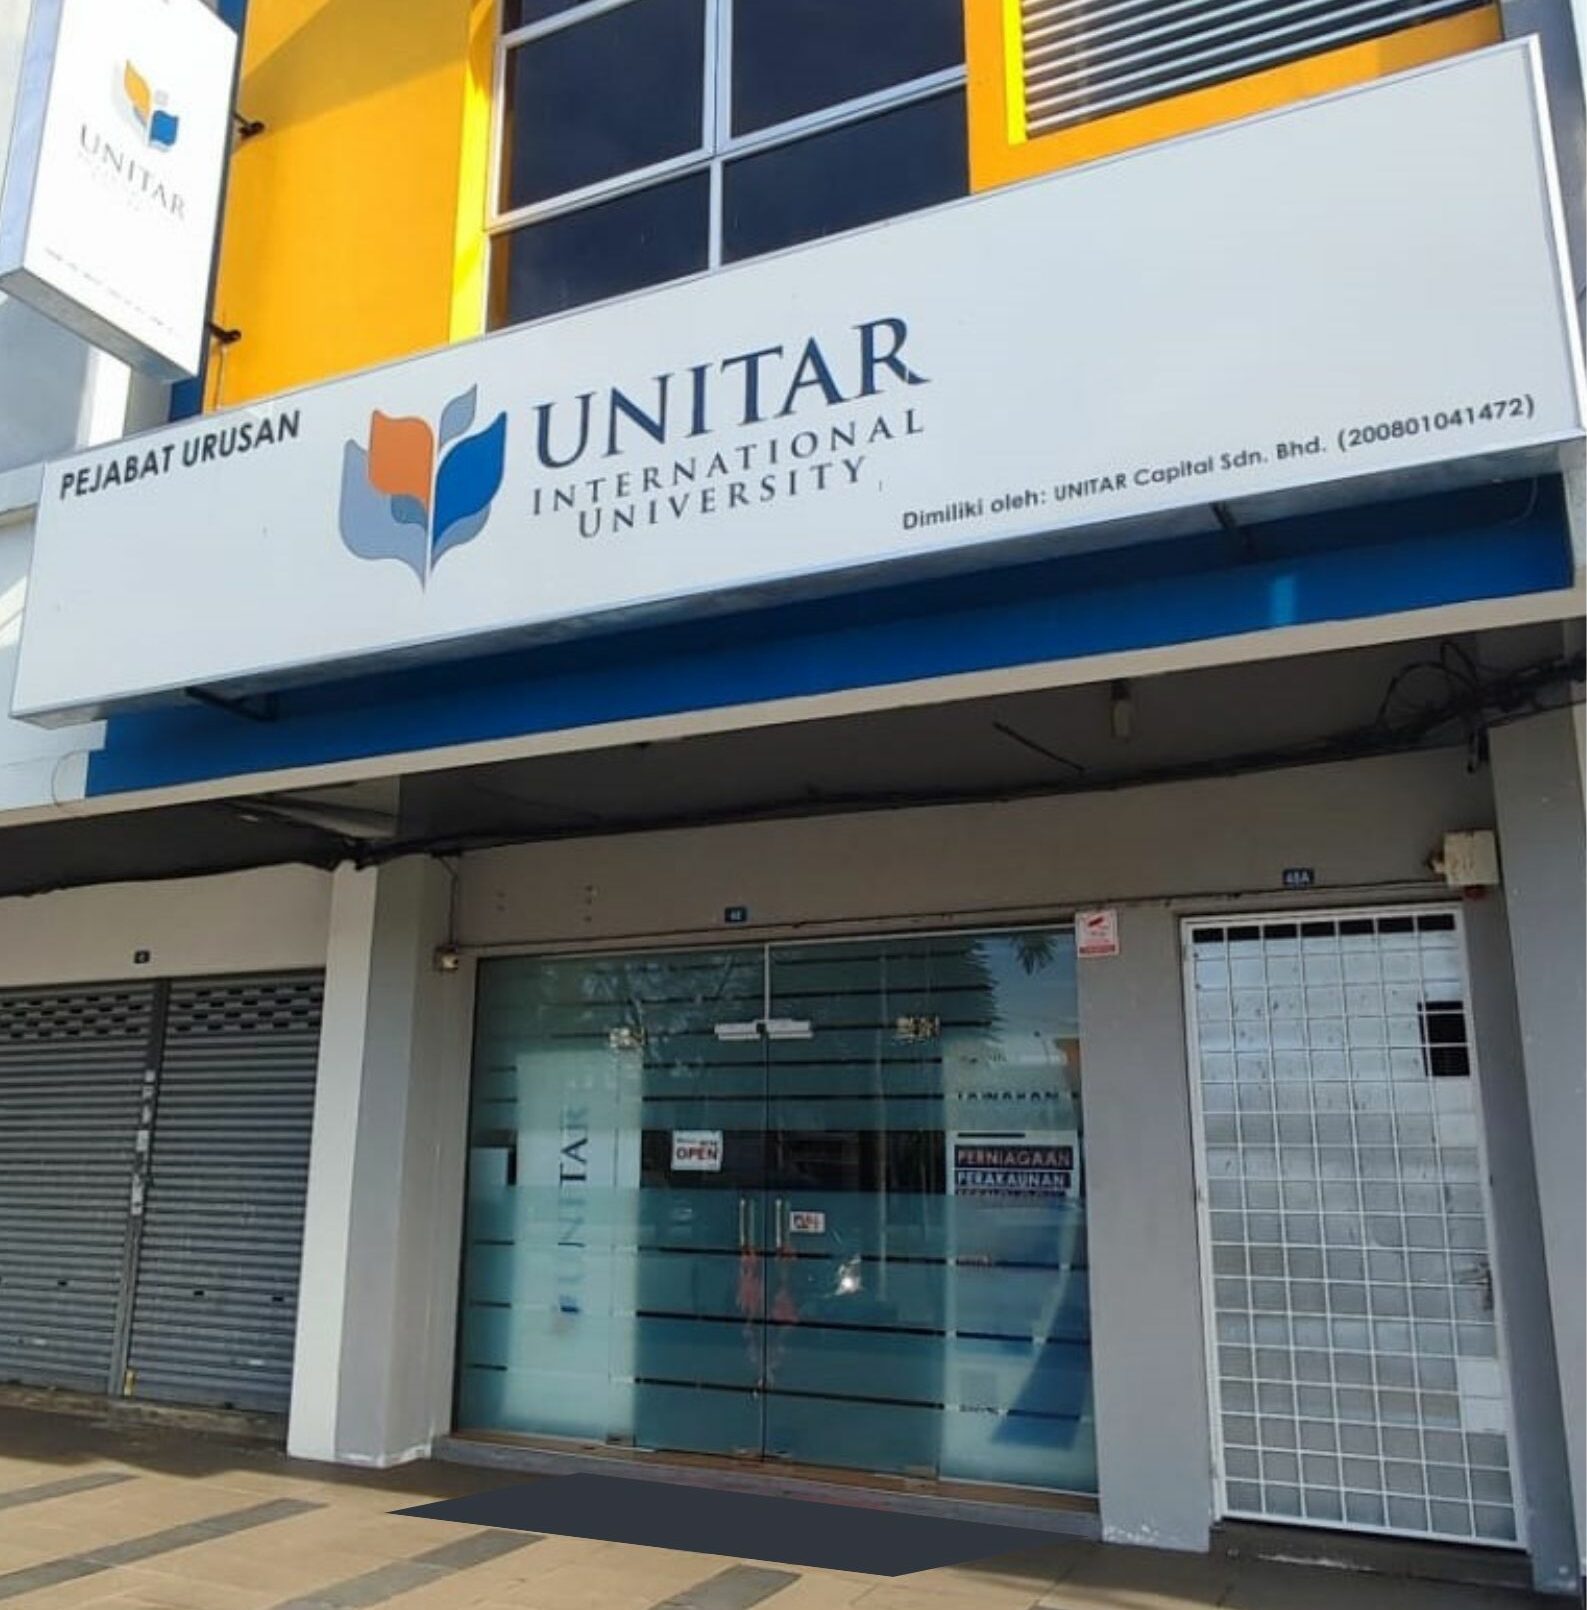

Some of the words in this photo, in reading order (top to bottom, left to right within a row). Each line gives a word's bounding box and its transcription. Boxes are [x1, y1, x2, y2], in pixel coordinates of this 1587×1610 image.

[80, 123, 186, 220] UNITAR
[532, 316, 931, 469] UNITAR
[60, 443, 175, 500] PEJABAT
[182, 410, 301, 466] URUSAN
[532, 408, 925, 516] INTERNATIONAL
[577, 455, 866, 539] UNIVERSITY
[902, 498, 984, 531] Dimiliki
[990, 487, 1047, 514] oleh:
[1053, 472, 1128, 502] UNITAR
[1133, 455, 1214, 487] Capital
[1220, 449, 1269, 471] Sdn.
[1275, 436, 1327, 461] Bhd.
[1337, 393, 1535, 453] (200801041472)
[676, 1146, 718, 1161] OPEN
